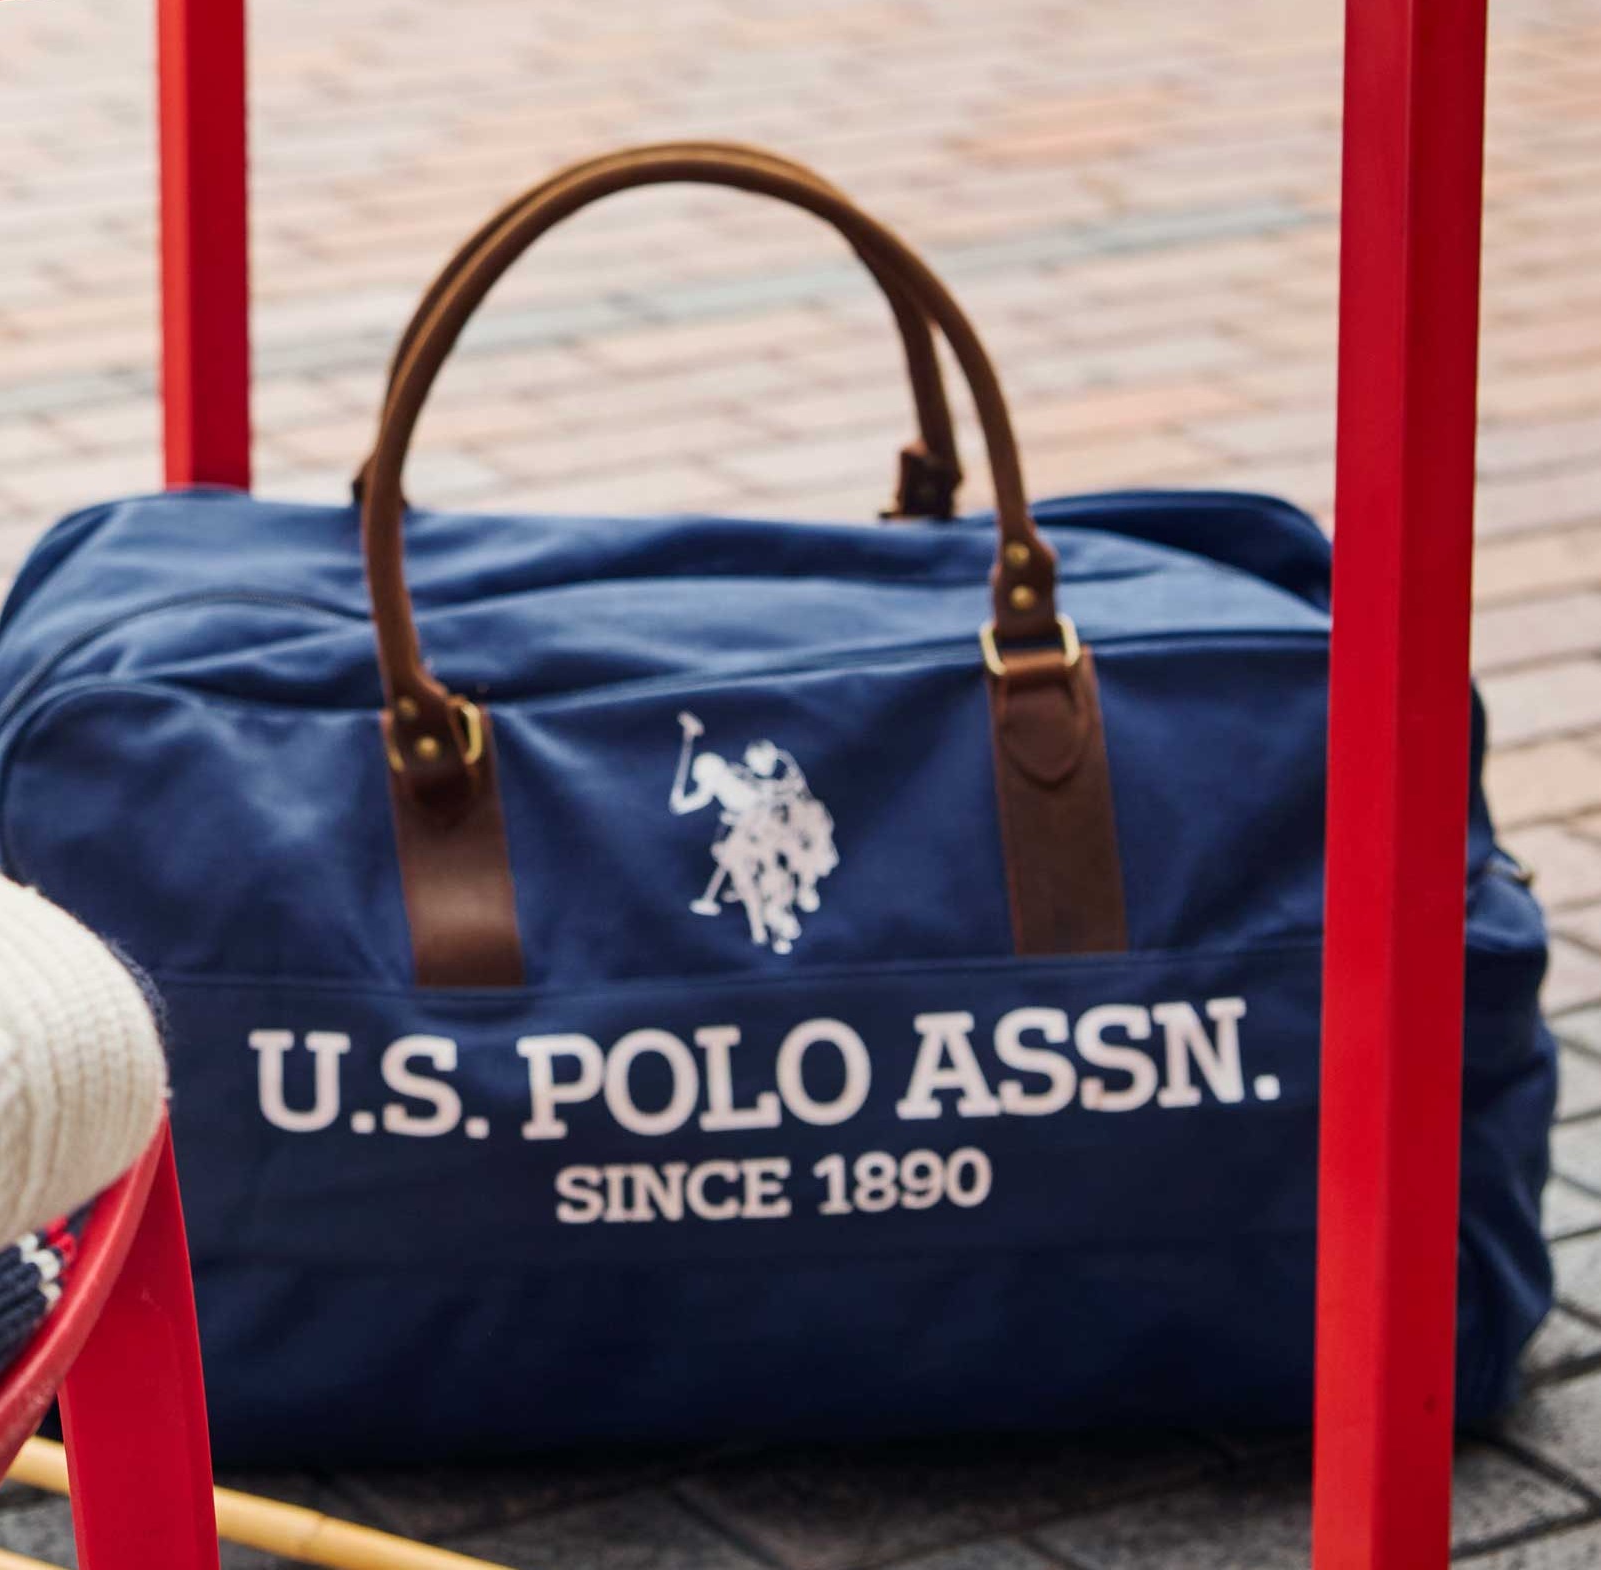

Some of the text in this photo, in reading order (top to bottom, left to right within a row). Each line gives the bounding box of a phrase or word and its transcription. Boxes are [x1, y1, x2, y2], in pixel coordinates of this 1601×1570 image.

[249, 997, 1280, 1140] U.S. POLO ASSN.
[557, 1148, 992, 1223] SINCE 1890
